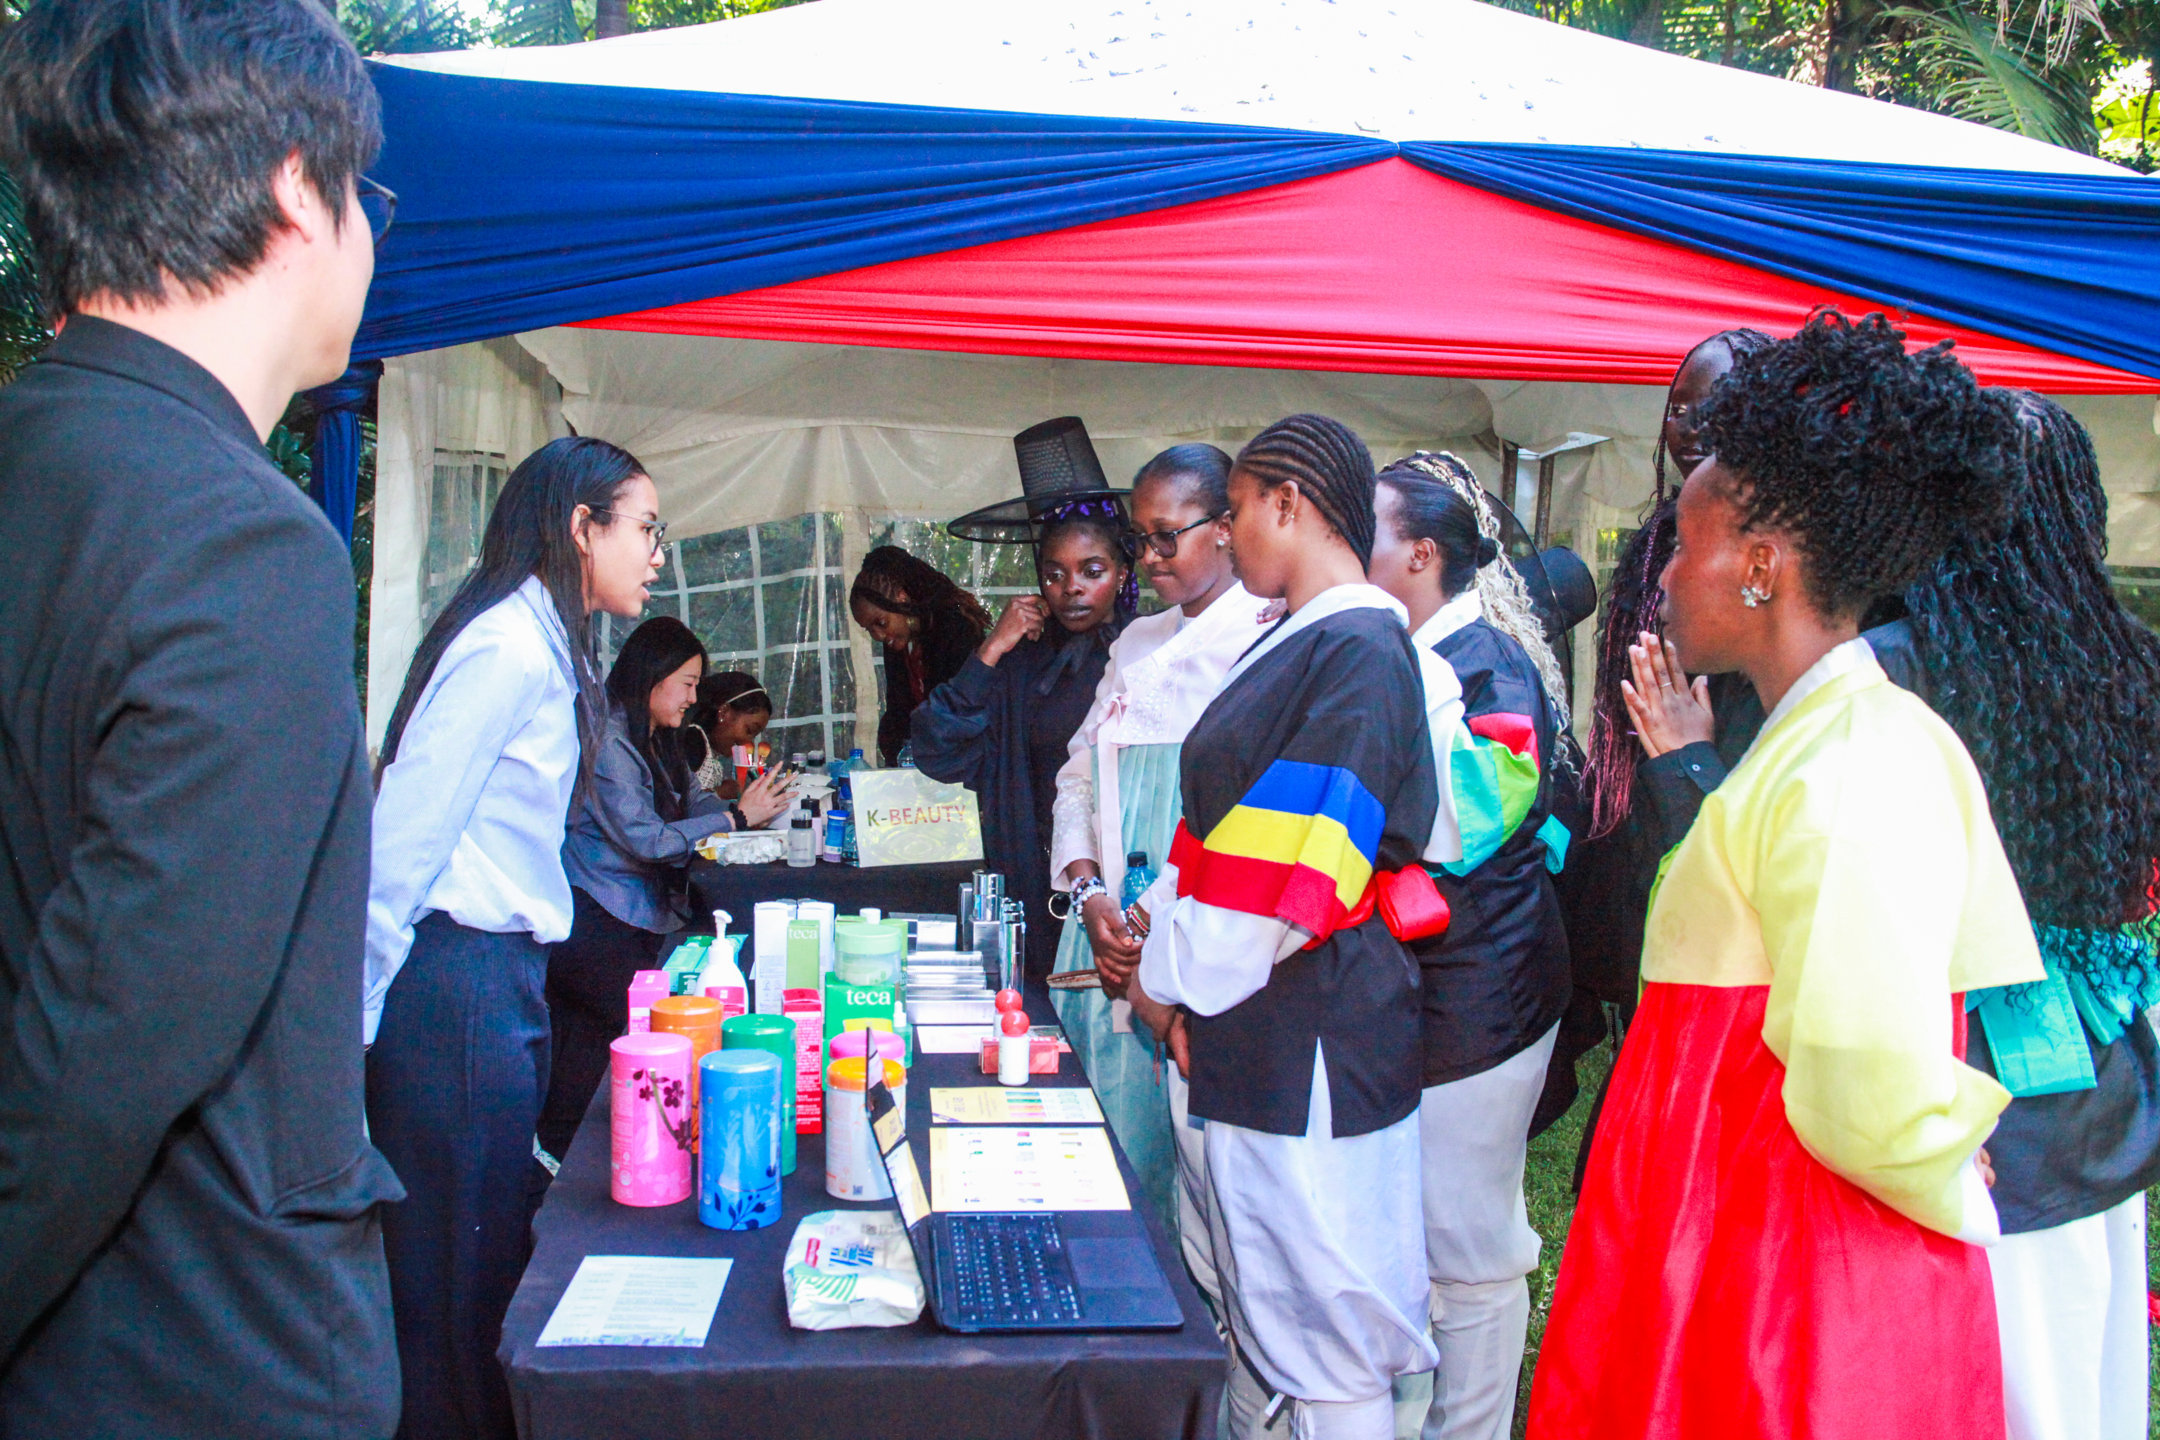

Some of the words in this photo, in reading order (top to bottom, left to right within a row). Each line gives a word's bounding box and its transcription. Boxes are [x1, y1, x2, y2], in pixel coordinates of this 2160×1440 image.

[867, 805, 966, 826] K-BEAUTY
[788, 927, 818, 940] teca
[846, 989, 891, 1006] teca
